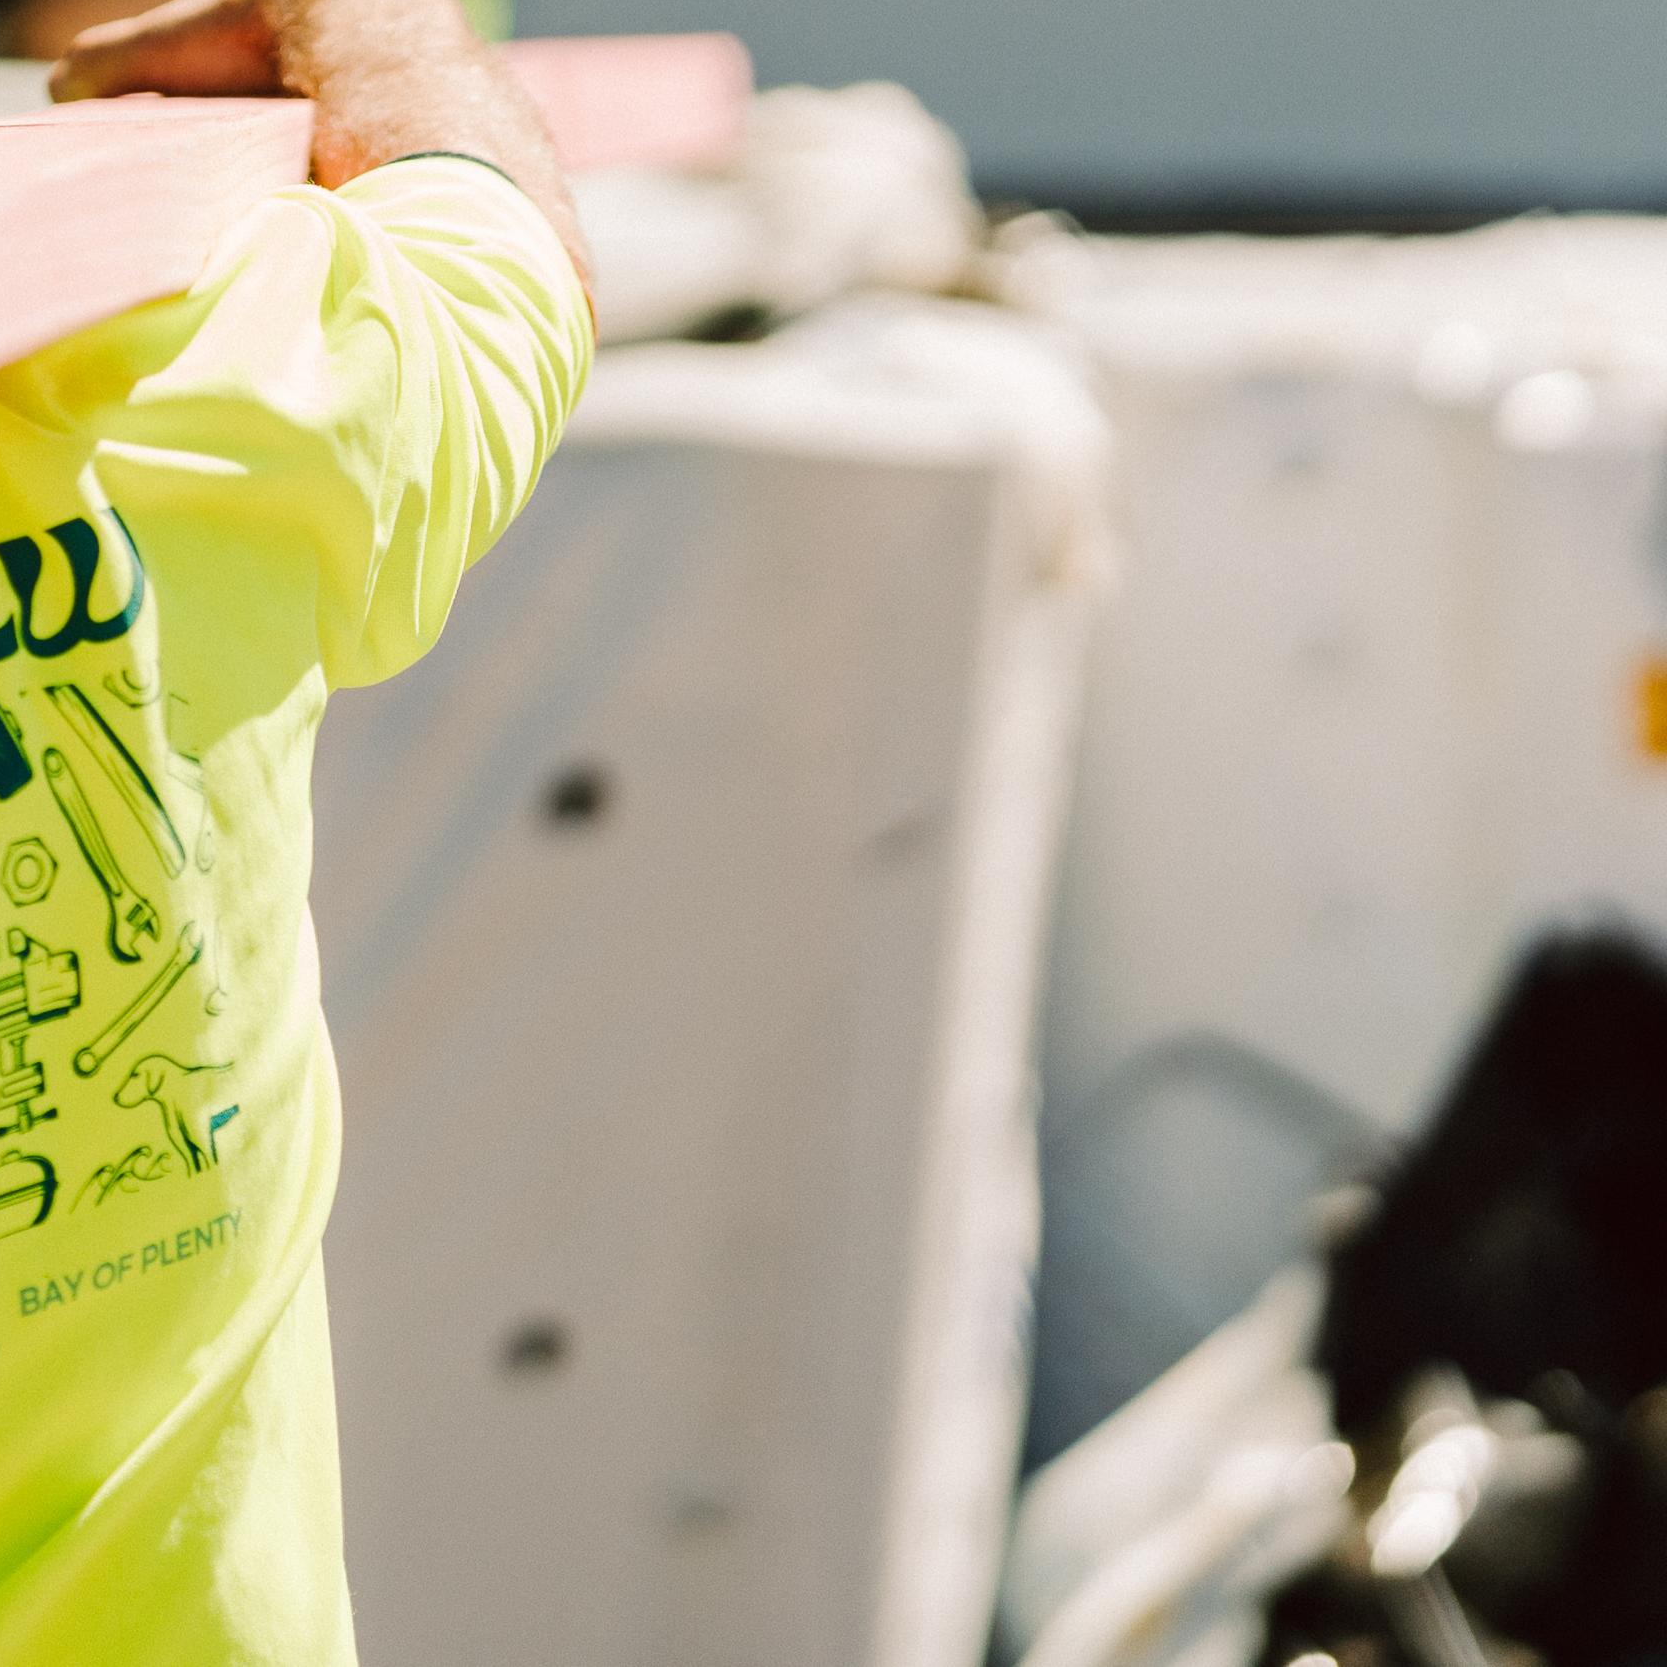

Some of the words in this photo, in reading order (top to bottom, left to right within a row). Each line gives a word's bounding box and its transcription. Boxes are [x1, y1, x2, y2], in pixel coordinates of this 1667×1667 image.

[19, 1271, 83, 1317] BAY
[93, 1253, 134, 1289] OF
[141, 1209, 242, 1274] PLENTY
